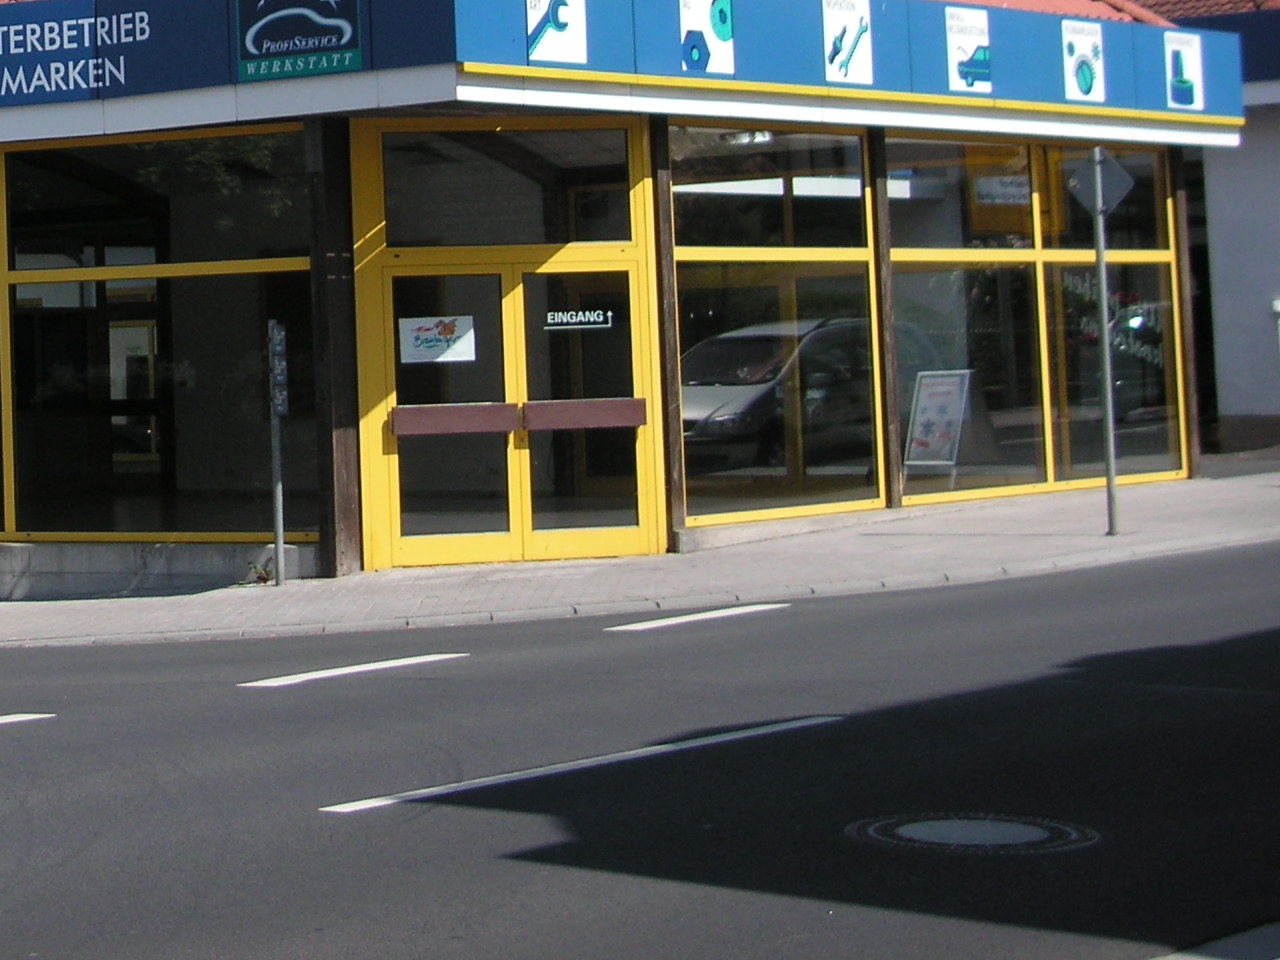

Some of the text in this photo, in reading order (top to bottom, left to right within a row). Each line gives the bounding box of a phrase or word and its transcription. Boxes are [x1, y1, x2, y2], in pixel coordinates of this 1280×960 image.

[529, 0, 541, 11] ART
[246, 53, 353, 75] WERKSTATT
[0, 55, 126, 95] MARKEN
[547, 309, 604, 324] EINGANG
